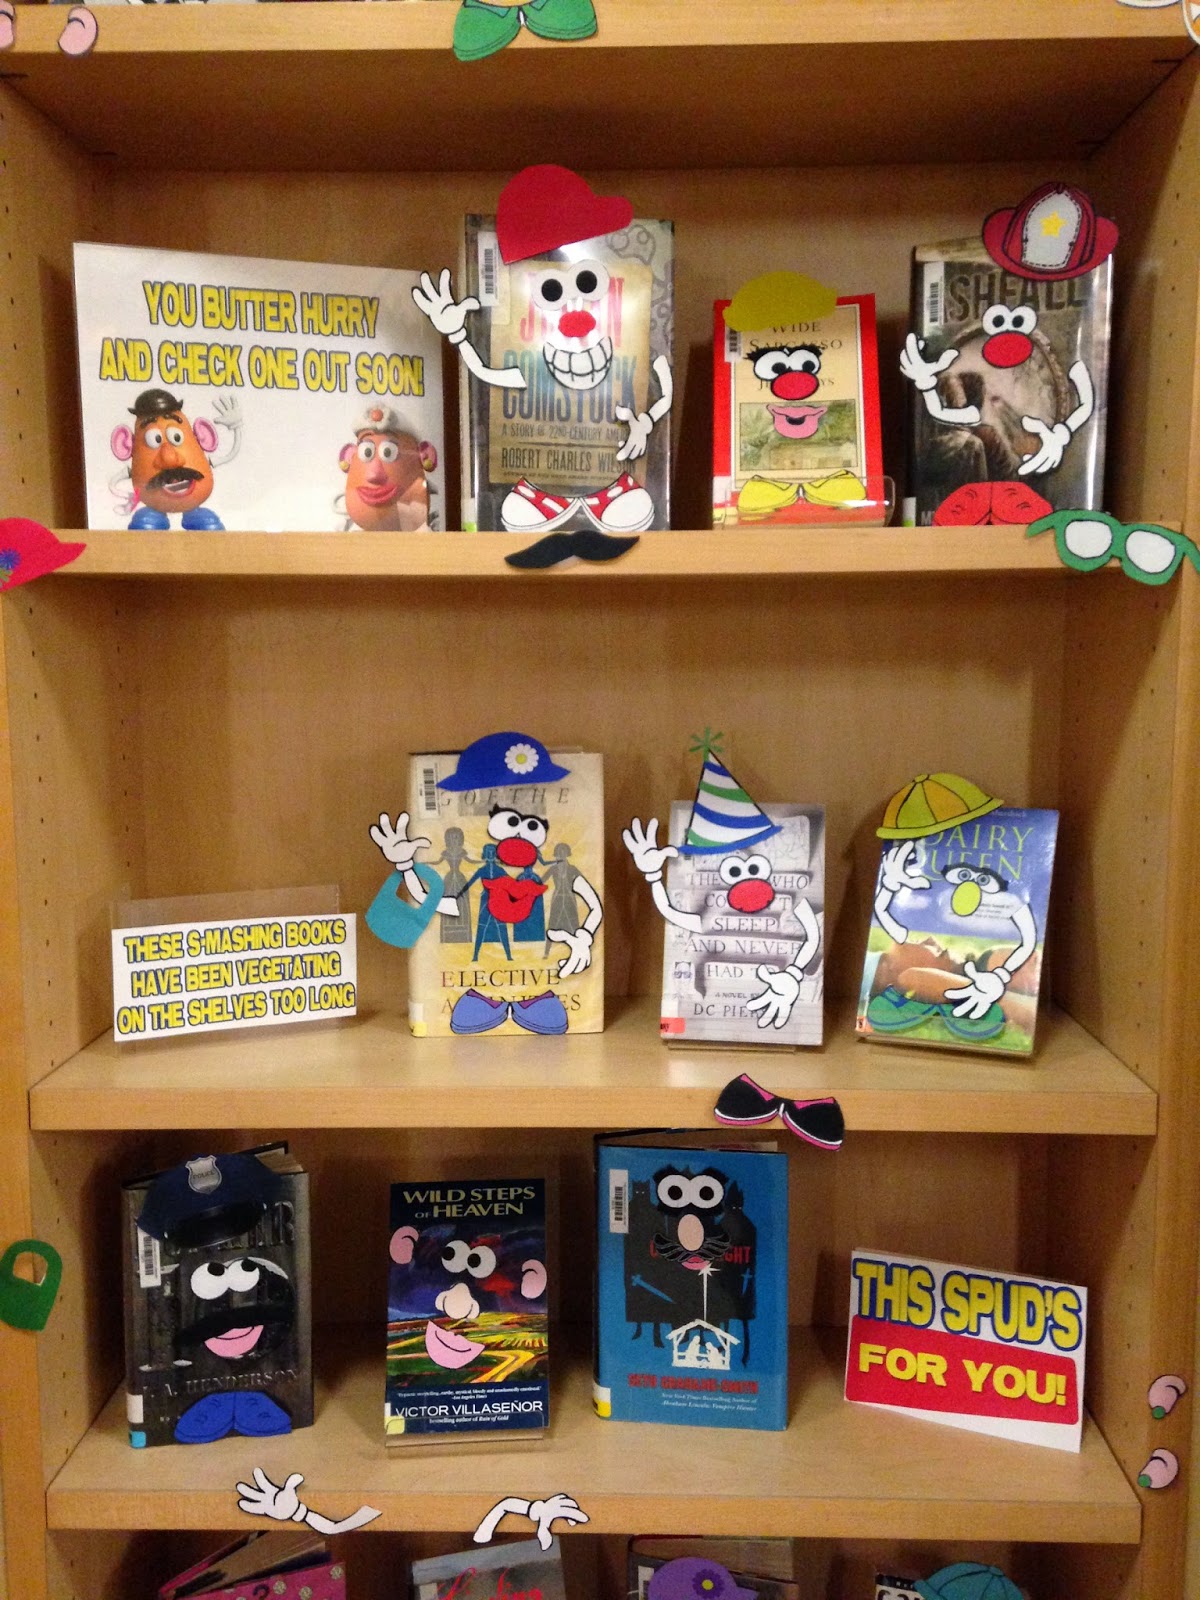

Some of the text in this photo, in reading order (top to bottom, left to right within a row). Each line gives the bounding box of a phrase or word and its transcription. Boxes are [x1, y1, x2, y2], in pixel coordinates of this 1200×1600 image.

[943, 273, 1088, 323] SHFALL
[142, 281, 380, 338] YOU BUTTER HURRY
[772, 321, 821, 333] WIDE
[99, 338, 425, 397] AND CHECK ONE OUT SOON!
[502, 423, 508, 437] A
[511, 423, 534, 438] STORY
[501, 447, 541, 469] ROBERT
[546, 450, 593, 472] CHARLES
[440, 786, 571, 807] GOETHE
[690, 872, 720, 886] THE
[711, 917, 777, 932] SLEEP
[123, 919, 346, 963] THESE S-MASHING BOOKS
[685, 937, 802, 955] AND NEVER
[131, 951, 341, 998] HAVE BEEN VEGETATING
[441, 968, 560, 988] ELECTIVE
[706, 964, 744, 978] HAD
[117, 982, 356, 1034] ON THE SHELVES TOO LONG
[693, 1004, 765, 1018] DC PIER
[402, 1186, 537, 1204] WILD STEPS
[433, 1202, 524, 1218] HEAVEN
[853, 1257, 1083, 1351] THIS SPUD'S
[186, 1368, 298, 1393] HENDERSON
[859, 1342, 1067, 1406] FOR YOU!
[395, 1400, 544, 1418] VICTOR VILLASEÑOR
